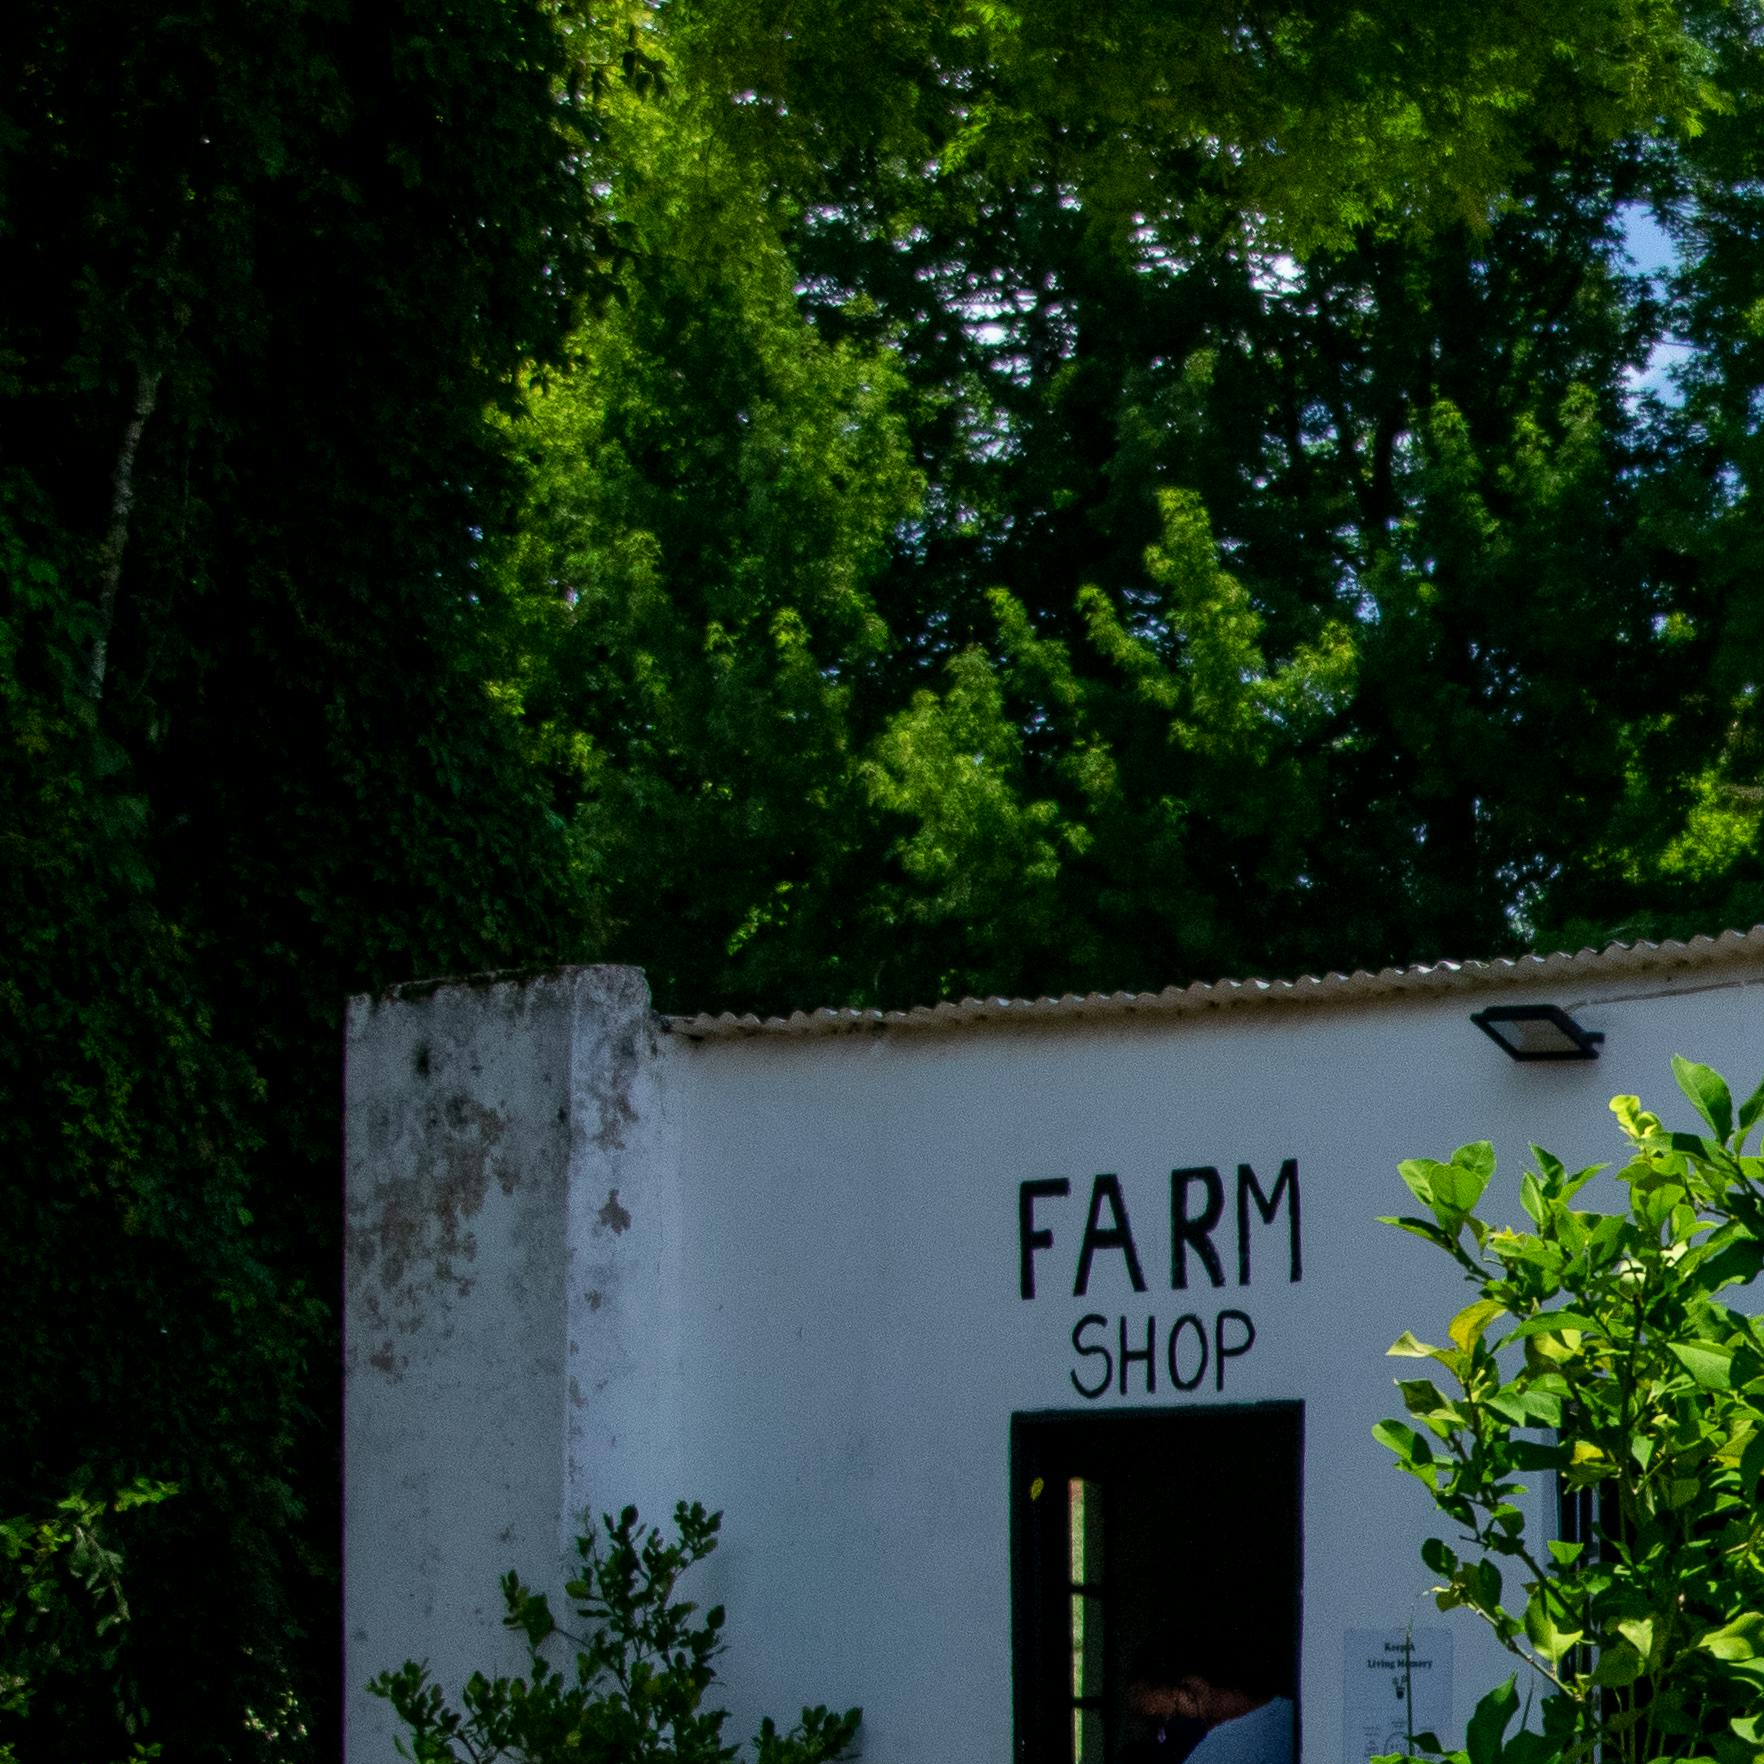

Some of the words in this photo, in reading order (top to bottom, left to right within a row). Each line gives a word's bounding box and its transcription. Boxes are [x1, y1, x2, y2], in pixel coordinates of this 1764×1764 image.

[1019, 1158, 1302, 1301] FARM
[1070, 1309, 1256, 1400] SHOP
[1367, 1659, 1395, 1670] Living
